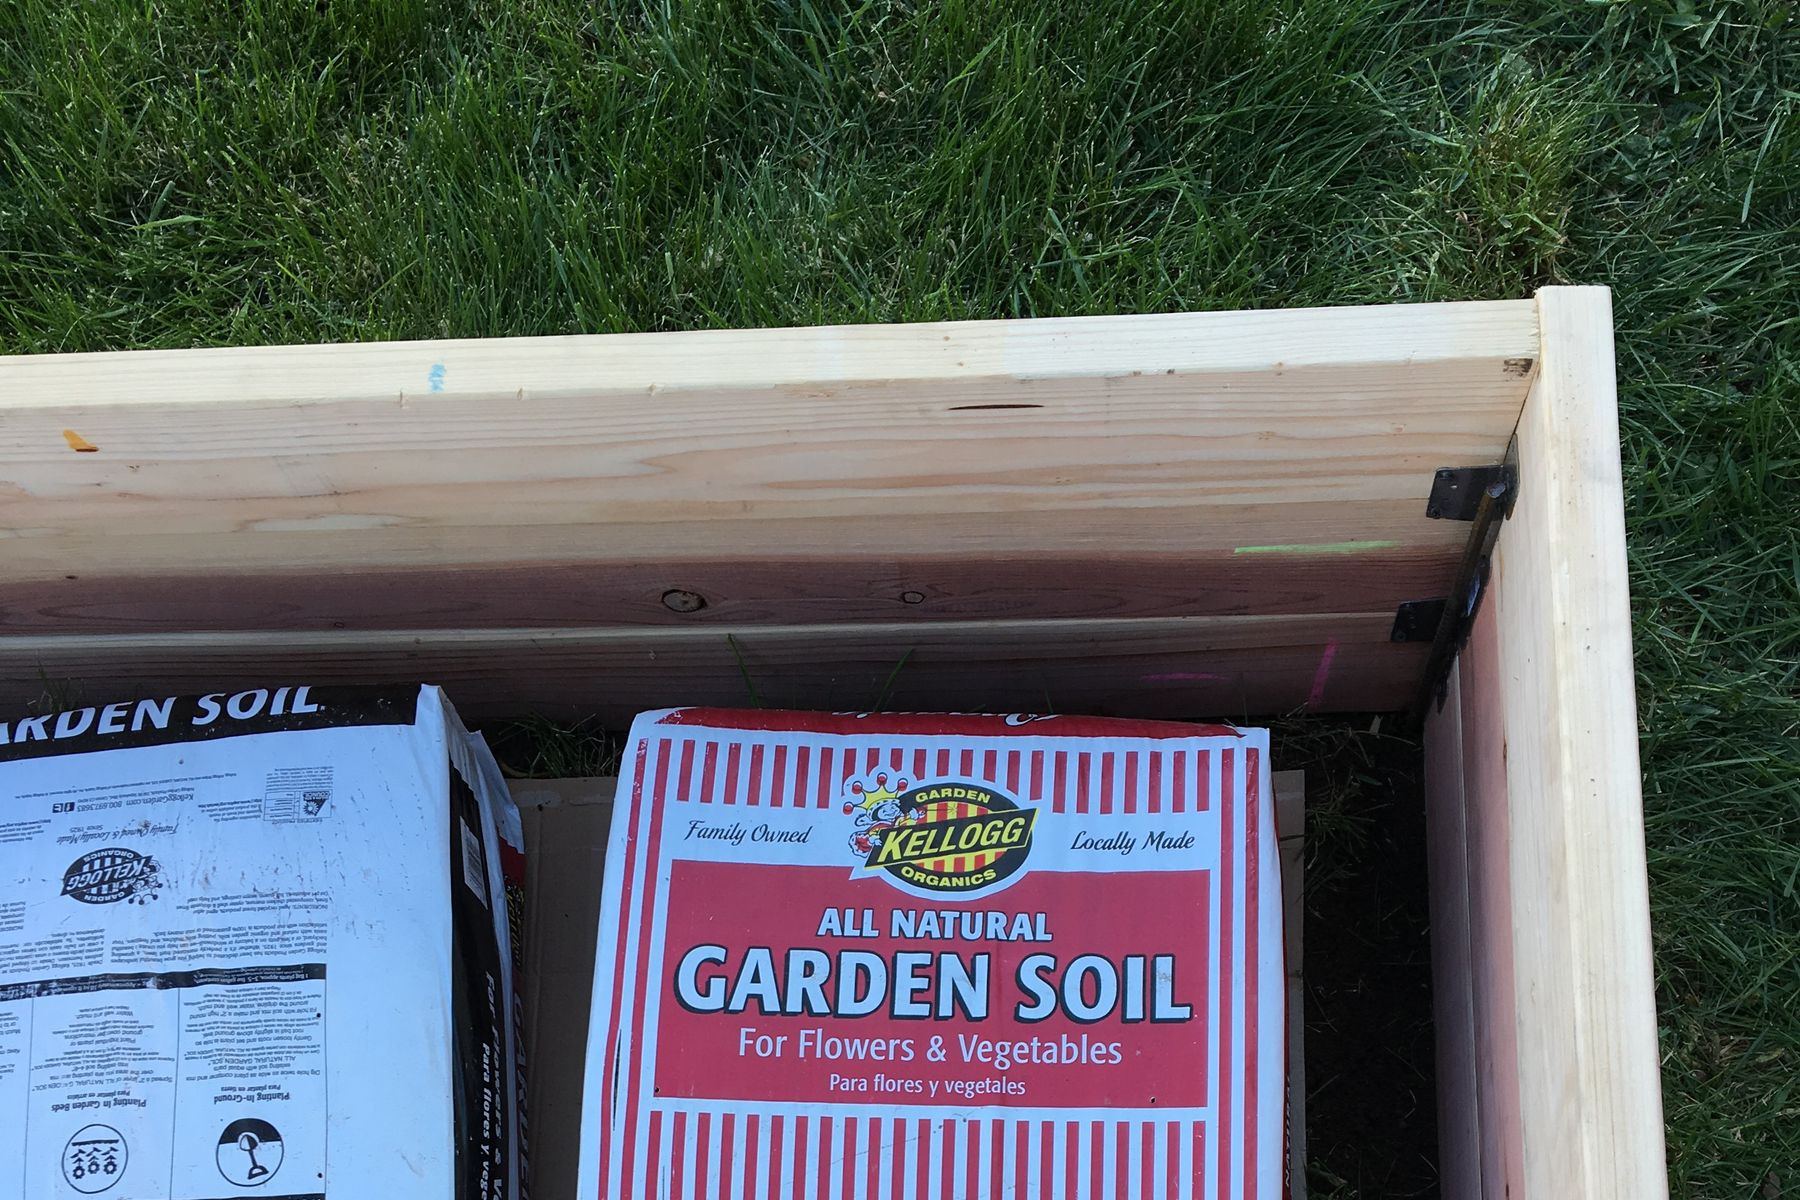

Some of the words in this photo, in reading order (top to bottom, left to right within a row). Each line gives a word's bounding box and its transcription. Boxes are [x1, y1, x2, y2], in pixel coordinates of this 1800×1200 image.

[0, 696, 176, 745] RDEN
[192, 686, 319, 726] SOIL
[915, 788, 991, 804] GARDEN
[80, 829, 110, 843] Locally
[684, 819, 747, 846] Family
[751, 823, 814, 844] Owned
[877, 817, 1026, 862] KELLOGG
[1070, 830, 1137, 855] Locally
[1142, 830, 1195, 852] Made
[82, 849, 134, 863] ORGANICS
[66, 858, 146, 891] KELLOGG
[901, 866, 997, 887] ORGANICS
[84, 891, 125, 903] GARDEN
[816, 906, 881, 938] ALL
[889, 907, 1054, 941] NATURAL
[674, 944, 992, 1021] GARDEN
[1014, 952, 1194, 1025] SOIL
[739, 1027, 788, 1058] For
[799, 1028, 916, 1062] Flowers
[926, 1035, 947, 1062] &
[958, 1033, 1123, 1071] Vegetables
[481, 1043, 491, 1083] Para
[256, 1091, 290, 1102] Planting
[829, 1073, 868, 1092] Para
[873, 1073, 923, 1093] flores
[929, 1079, 940, 1098] y
[944, 1076, 1026, 1099] vegetales
[51, 1103, 70, 1113] Beds
[72, 1100, 100, 1111] Garden
[103, 1100, 111, 1109] In
[113, 1097, 147, 1108] Planting
[213, 1095, 255, 1105] In-Ground
[481, 1087, 493, 1140] flores
